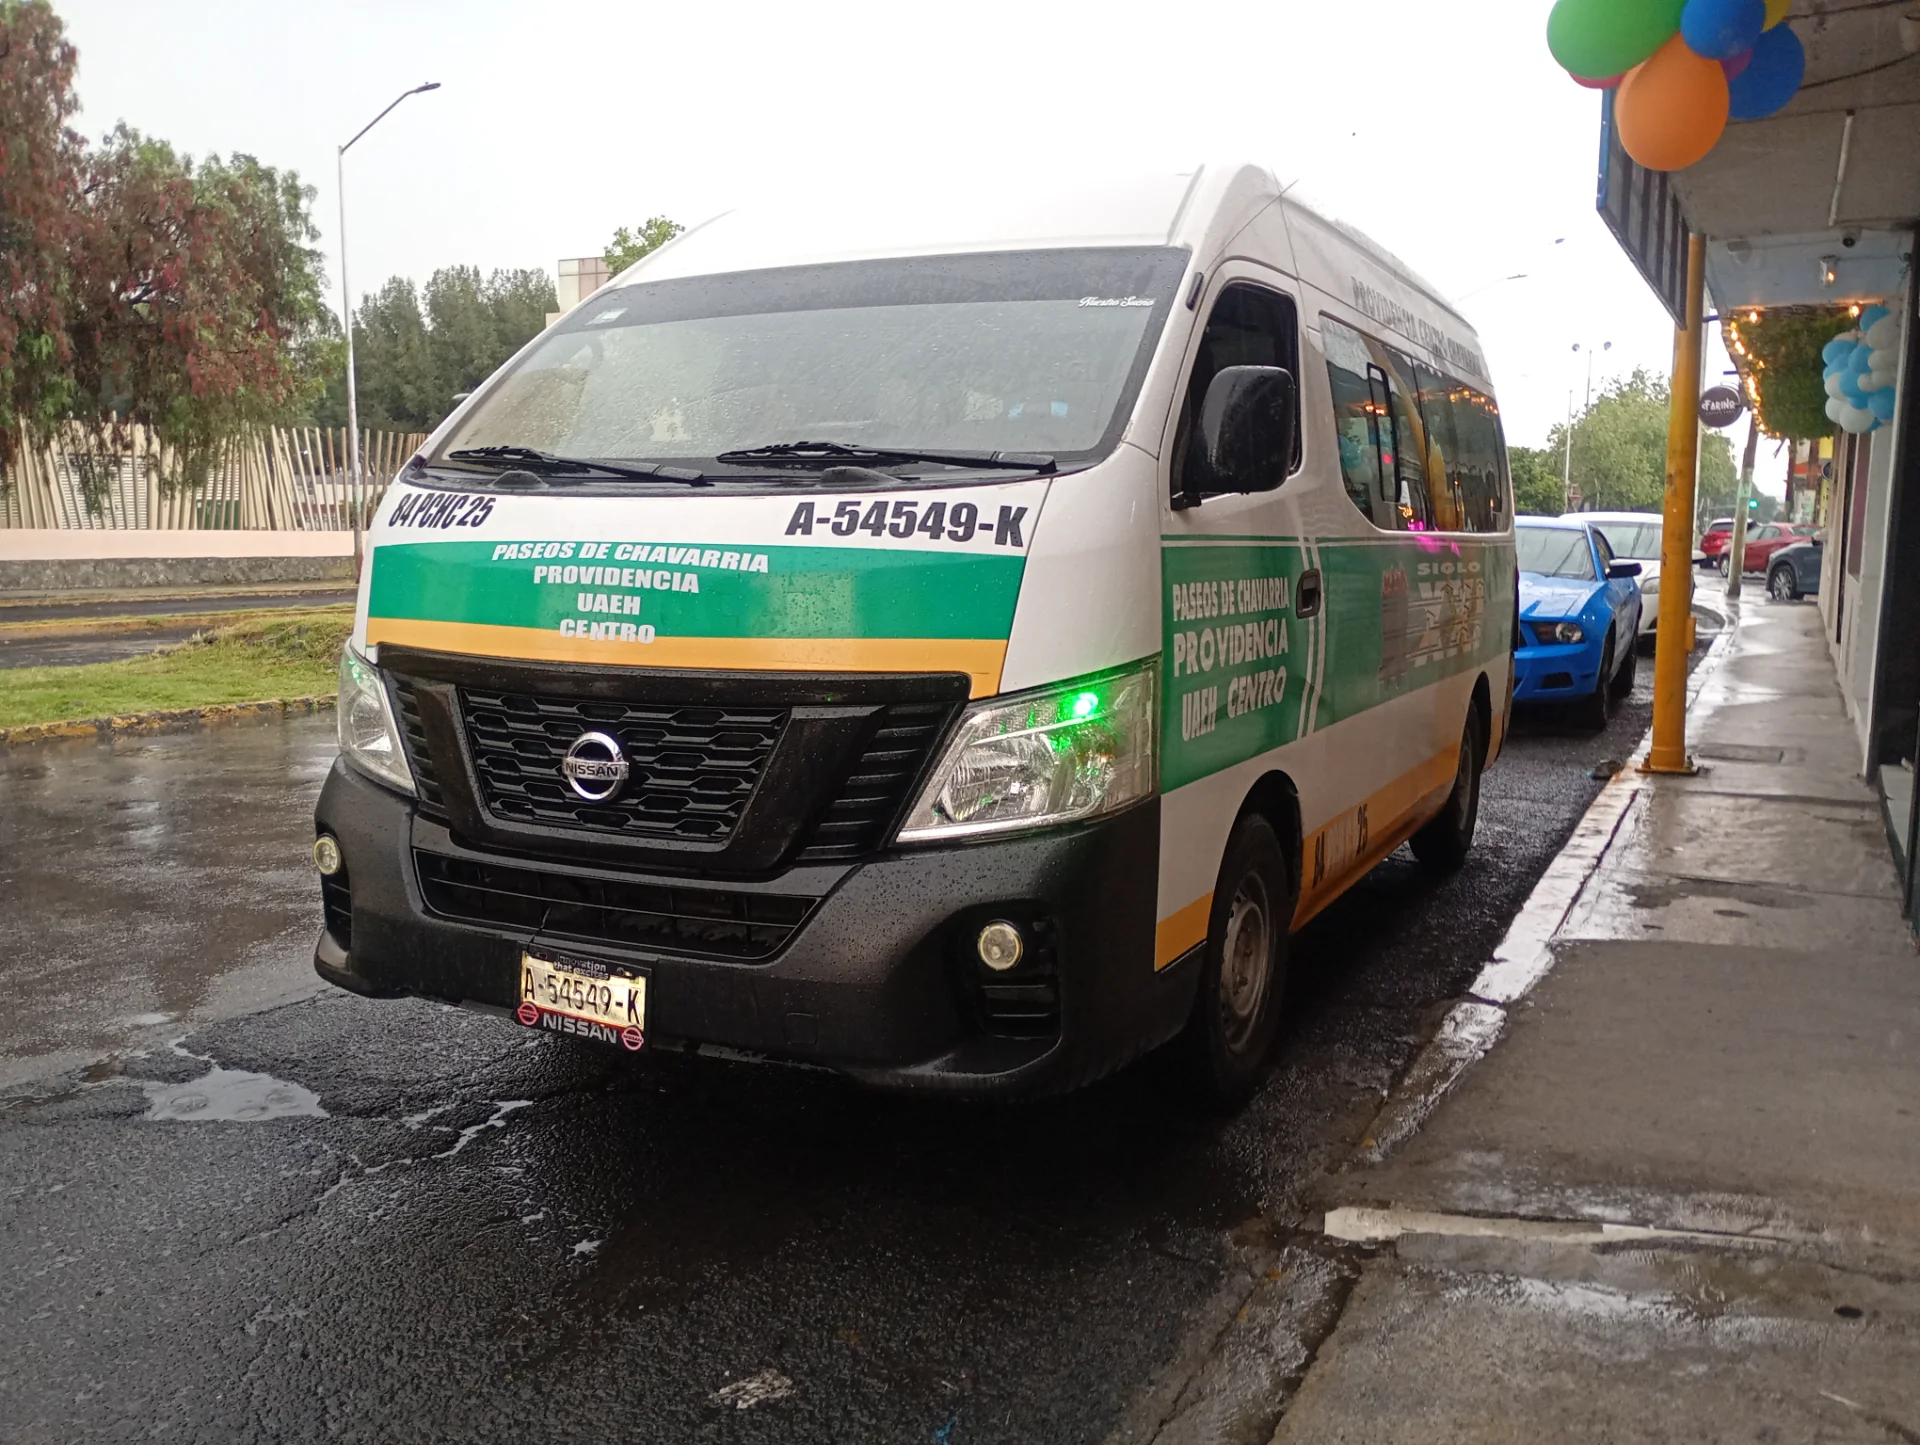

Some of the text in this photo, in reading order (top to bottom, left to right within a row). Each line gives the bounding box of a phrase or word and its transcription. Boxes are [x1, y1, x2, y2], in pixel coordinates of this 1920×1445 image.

[785, 501, 1028, 547] A-54549-K
[492, 543, 769, 573] PASEOS DE CHAVARRIA
[533, 565, 699, 593] PROVIDENCIA
[577, 593, 641, 615] UAEH
[1172, 577, 1290, 621] PASEOS DE CHAVARRIA
[559, 619, 656, 644] CENTRO
[1173, 618, 1289, 677] PROVIDENCIA
[1182, 666, 1287, 741] UAEH CENTRO
[565, 762, 618, 777] NISSAN
[553, 961, 572, 973] that
[524, 967, 640, 1025] A-54549-K
[543, 1012, 618, 1044] NISSAN
